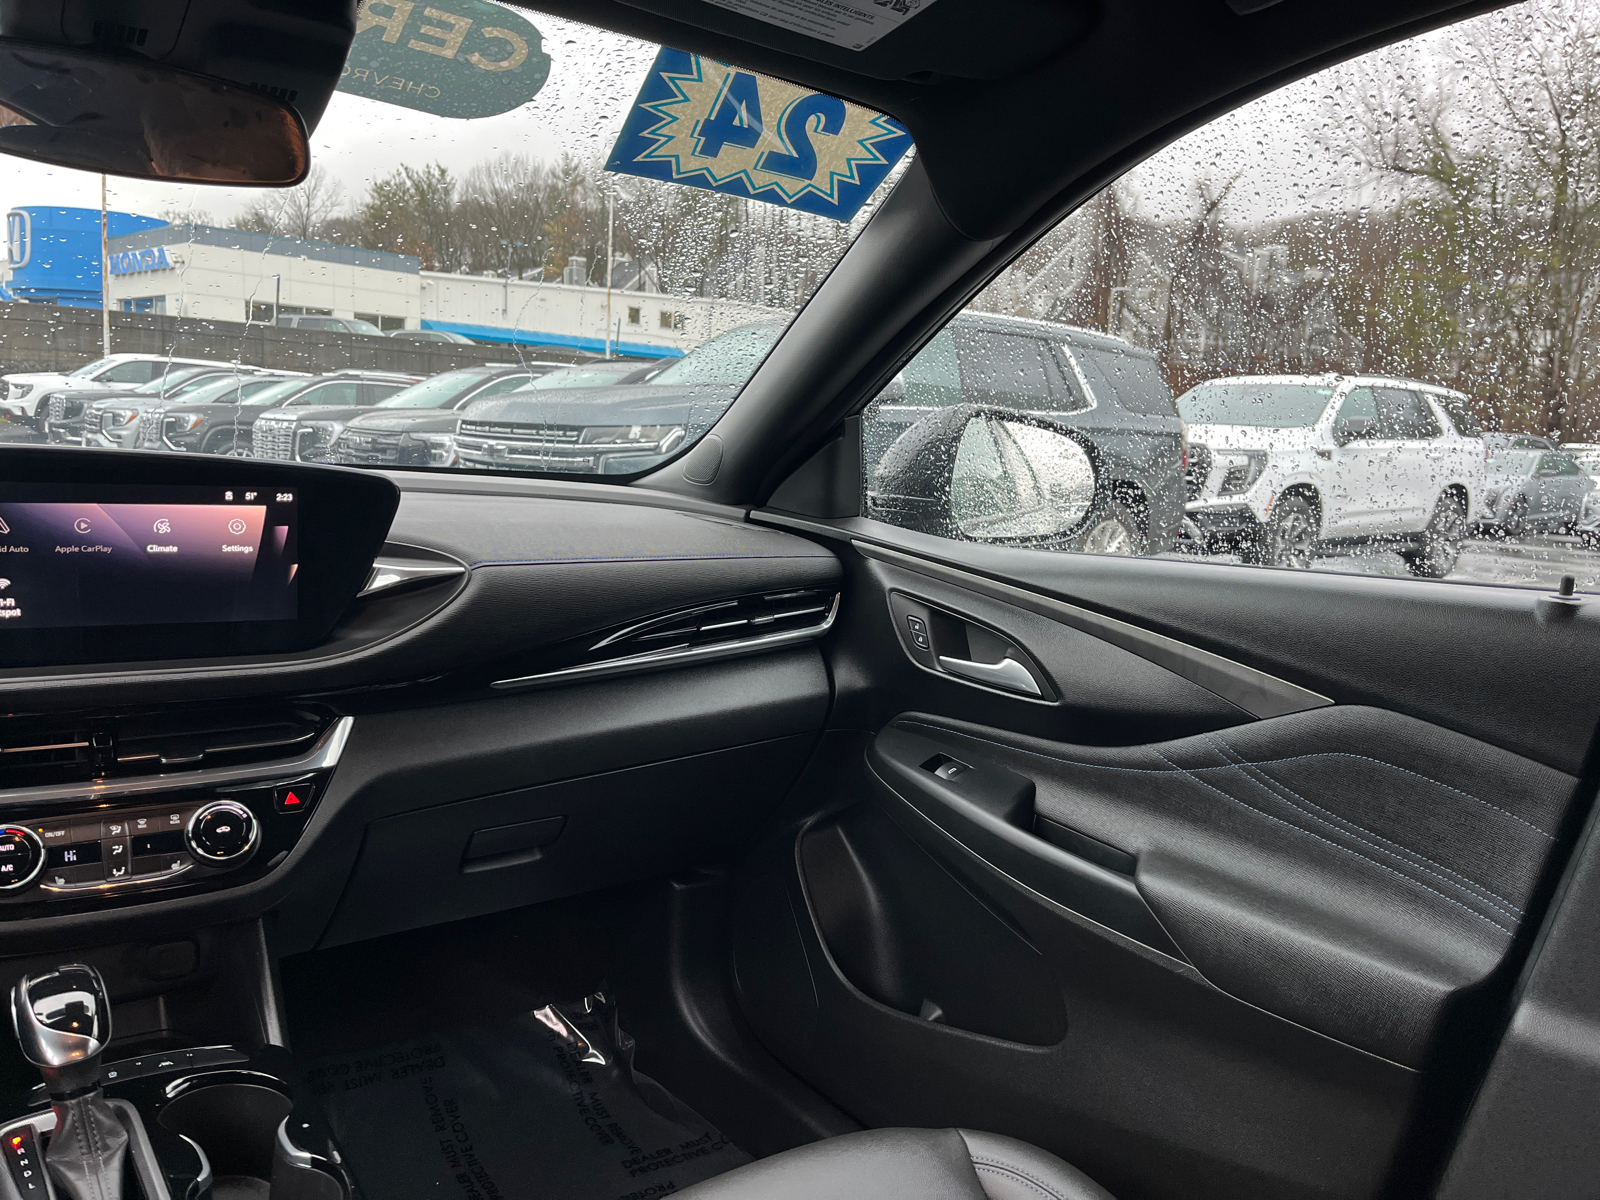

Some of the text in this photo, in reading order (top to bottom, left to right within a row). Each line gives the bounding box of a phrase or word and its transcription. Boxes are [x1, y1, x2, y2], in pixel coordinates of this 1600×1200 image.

[833, 3, 875, 20] INTELLIGENTS
[109, 247, 169, 275] HONDA
[276, 492, 293, 502] 2:23
[9, 545, 30, 553] Auto
[55, 544, 113, 555] Apple CarPlay
[146, 544, 179, 554] Climate
[221, 544, 254, 555] Settings
[44, 830, 66, 838] ON/OFF
[64, 850, 77, 862] Hi
[1, 864, 14, 872] A/C
